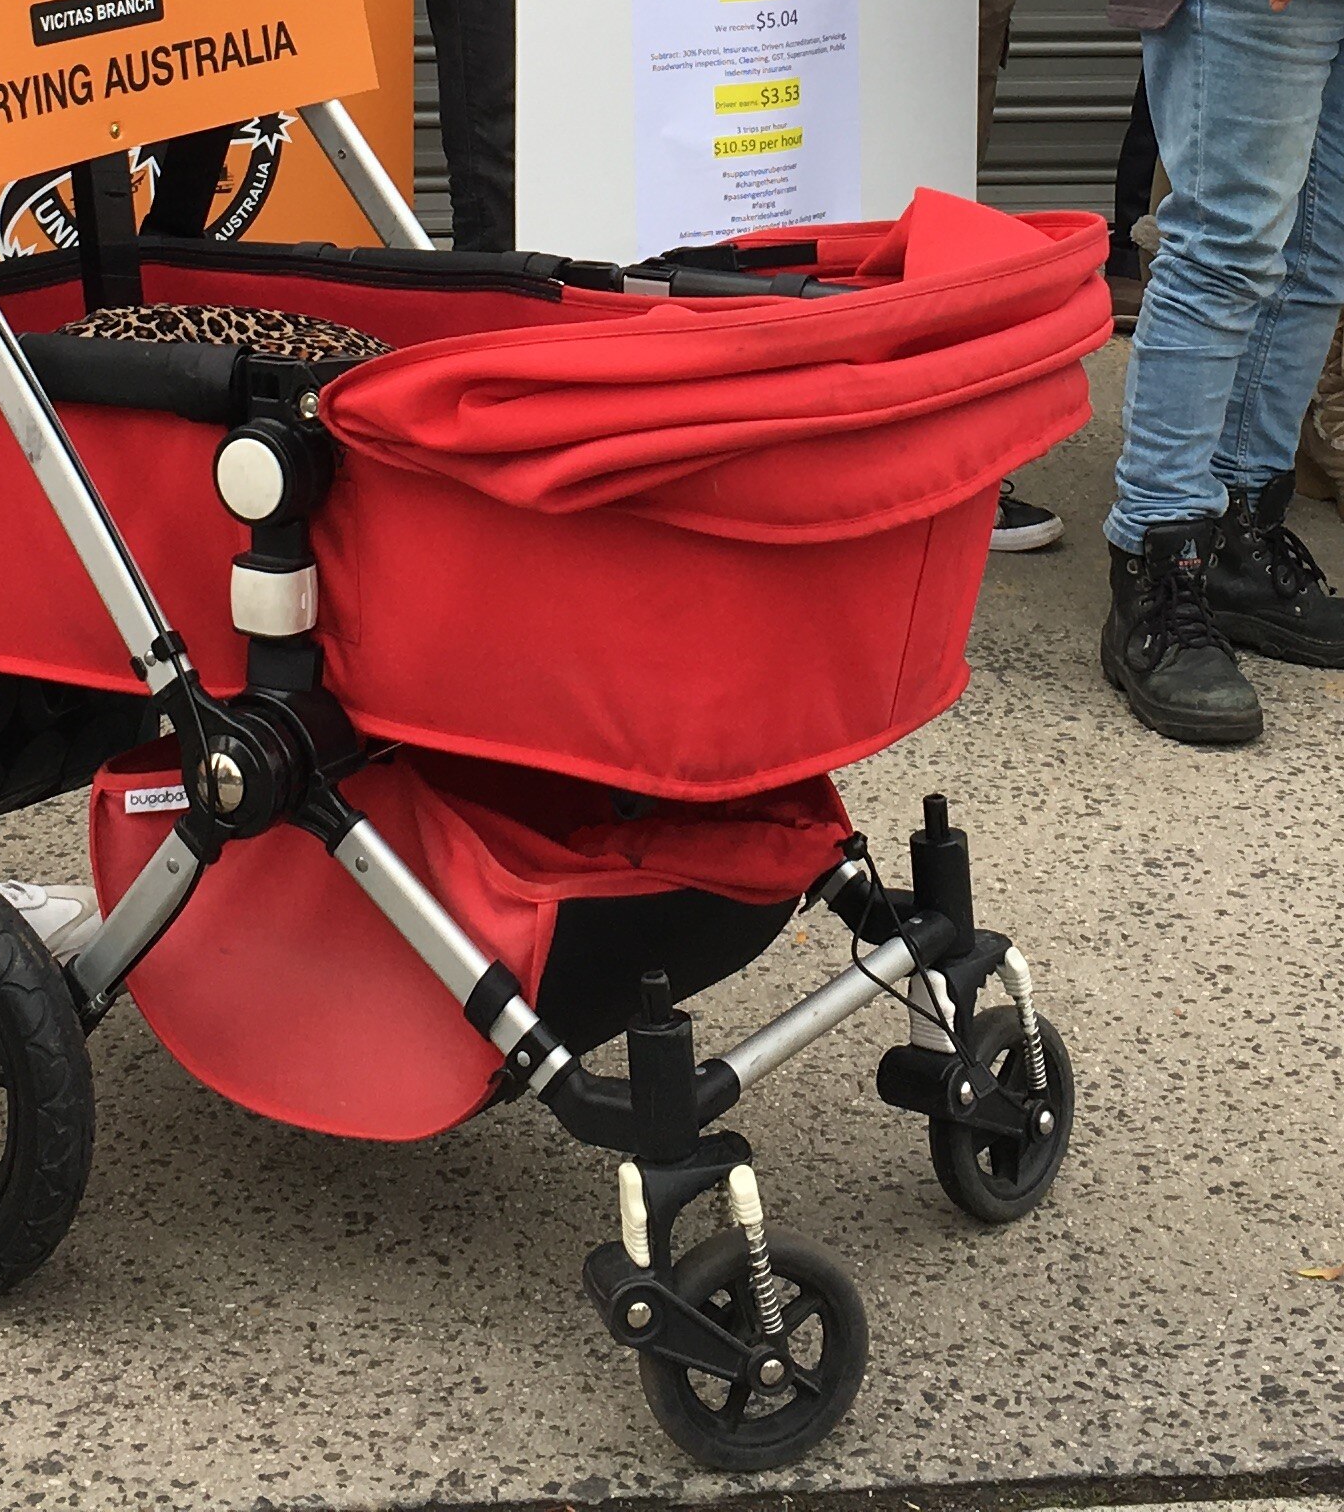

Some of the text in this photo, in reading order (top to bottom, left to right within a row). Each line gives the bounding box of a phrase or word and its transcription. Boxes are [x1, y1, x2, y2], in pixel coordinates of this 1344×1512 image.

[40, 6, 93, 32] VIC/TAS
[729, 24, 755, 32] receive
[756, 9, 798, 32] $5.04
[104, 20, 297, 99] AUSTRALIA
[652, 61, 693, 72] Roadworthy
[716, 101, 736, 109] Driver
[761, 85, 799, 107] $3.53
[760, 125, 771, 133] per
[714, 134, 802, 156] $10.59 per hour
[679, 230, 713, 239] Minimum
[715, 228, 735, 236] wage
